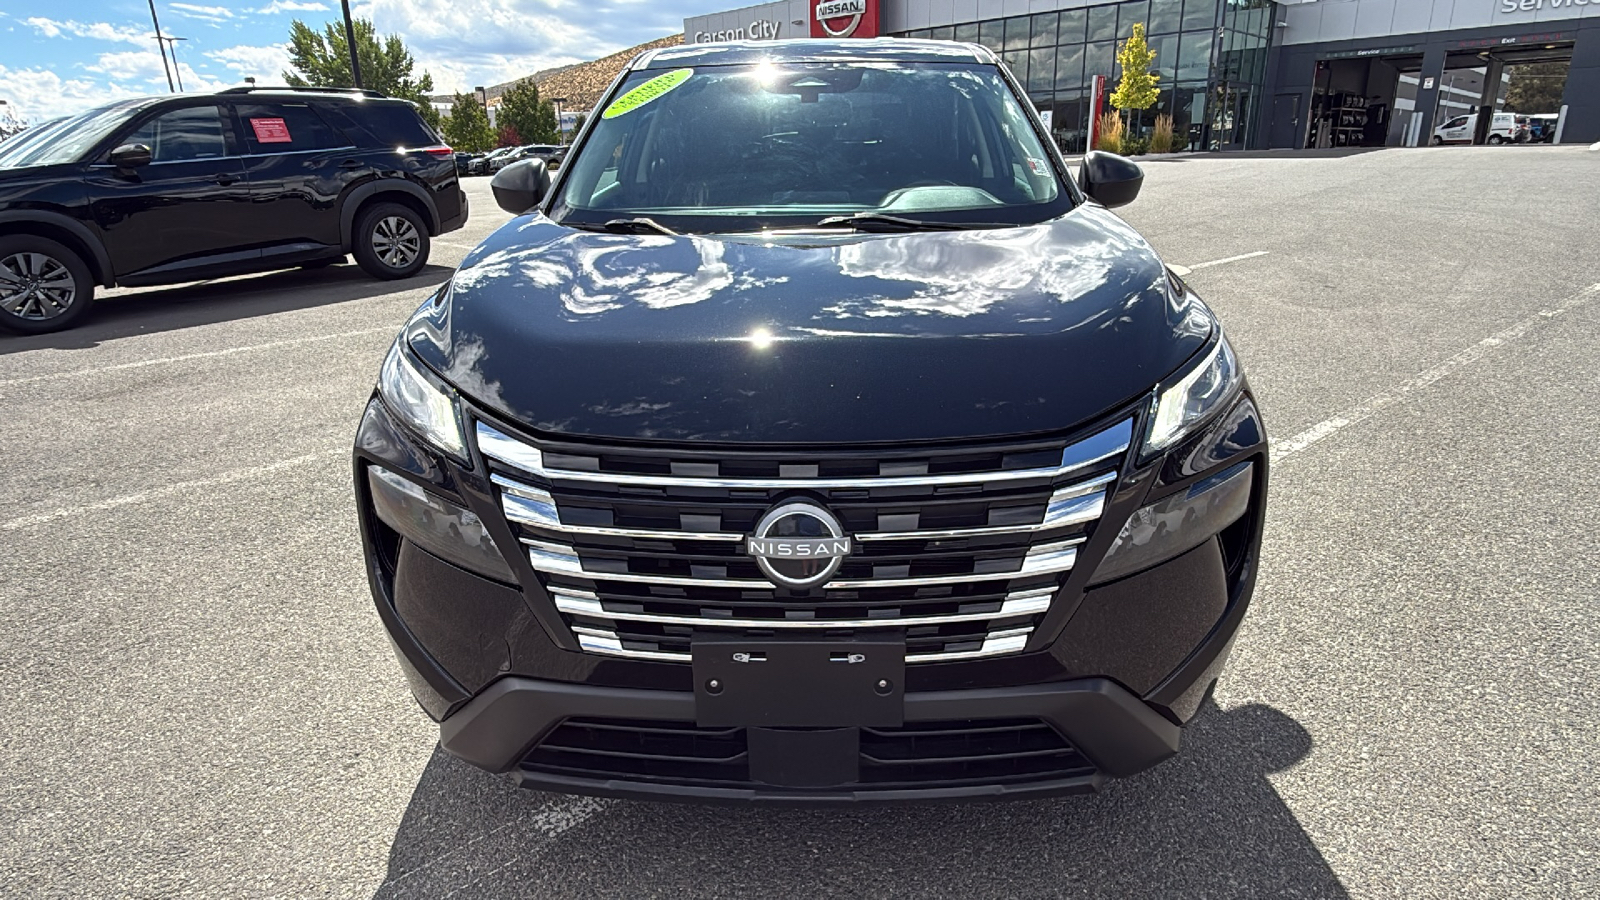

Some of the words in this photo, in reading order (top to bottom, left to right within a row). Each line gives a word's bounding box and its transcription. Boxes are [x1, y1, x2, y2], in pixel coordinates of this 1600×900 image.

[819, 1, 859, 16] NISSAN
[694, 28, 745, 44] Carson
[749, 20, 779, 40] City
[750, 541, 848, 556] NISSAN
